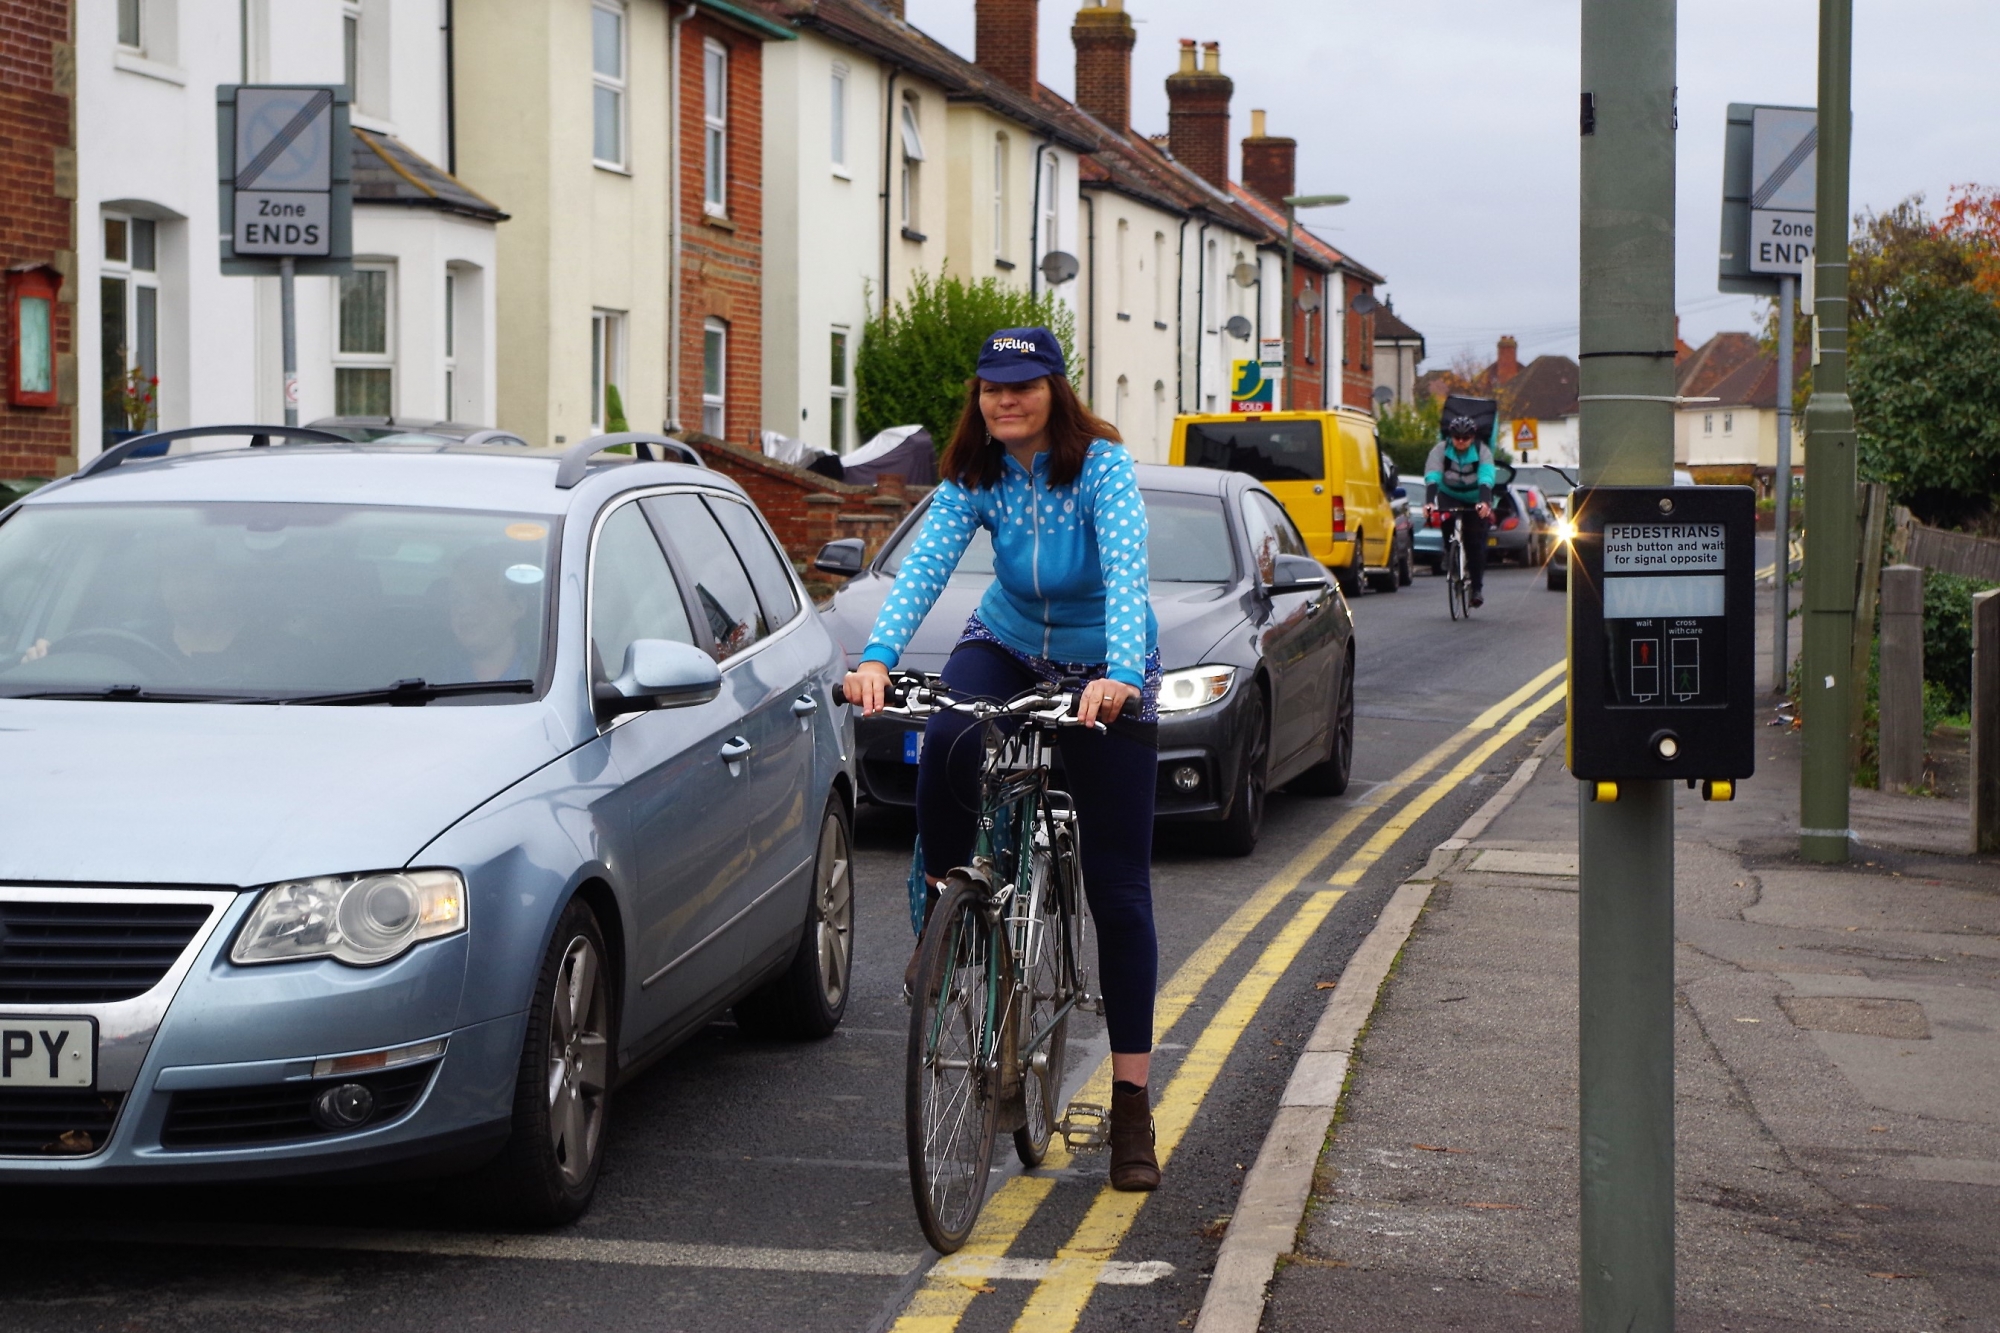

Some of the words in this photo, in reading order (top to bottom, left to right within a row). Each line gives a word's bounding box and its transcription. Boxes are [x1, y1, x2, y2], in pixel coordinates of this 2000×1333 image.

[259, 200, 306, 217] Zone
[245, 223, 319, 245] ENDS
[1772, 219, 1813, 237] Zone
[1760, 243, 1816, 264] END
[992, 339, 1036, 352] cycling
[1238, 402, 1264, 412] SOLD
[1611, 526, 1720, 540] PEDESTRIANS
[1606, 543, 1633, 553] push
[1636, 542, 1673, 552] button
[1677, 541, 1698, 551] and
[1701, 540, 1725, 550] wait
[1614, 554, 1630, 564] for
[1634, 554, 1667, 565] signal
[1670, 553, 1718, 565] opposite
[1611, 580, 1720, 614] WAIT
[2, 1030, 70, 1078] PY
